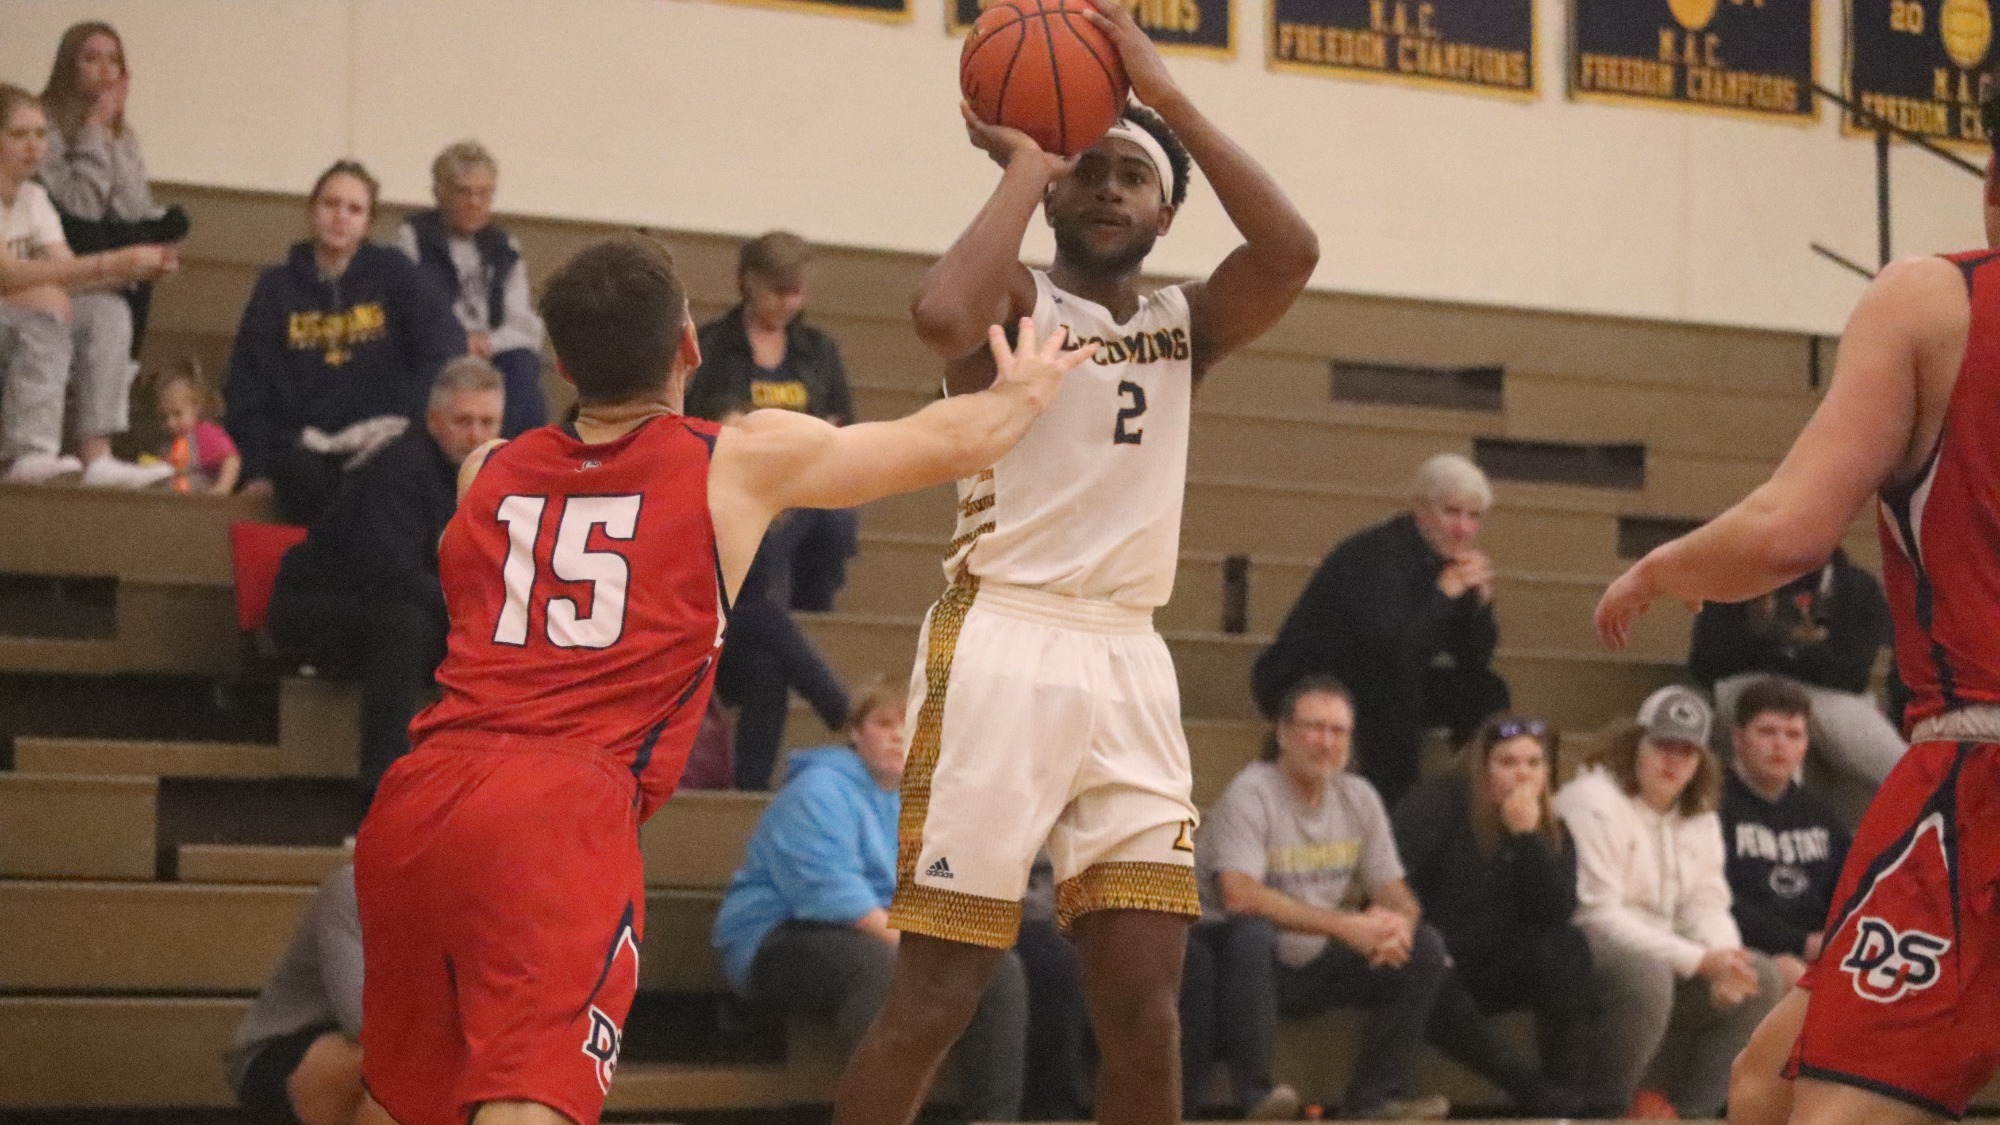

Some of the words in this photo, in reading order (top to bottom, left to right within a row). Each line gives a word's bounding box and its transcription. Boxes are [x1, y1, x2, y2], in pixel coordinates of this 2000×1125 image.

[1279, 23, 1385, 71] FREEDOM
[1398, 37, 1528, 87] CHAMPIONS
[1580, 54, 1674, 97] FREEDOM
[1686, 66, 1798, 112] CHAMPIONS
[1114, 380, 1147, 445] 2
[492, 491, 645, 651] 15
[925, 869, 954, 879] adidas
